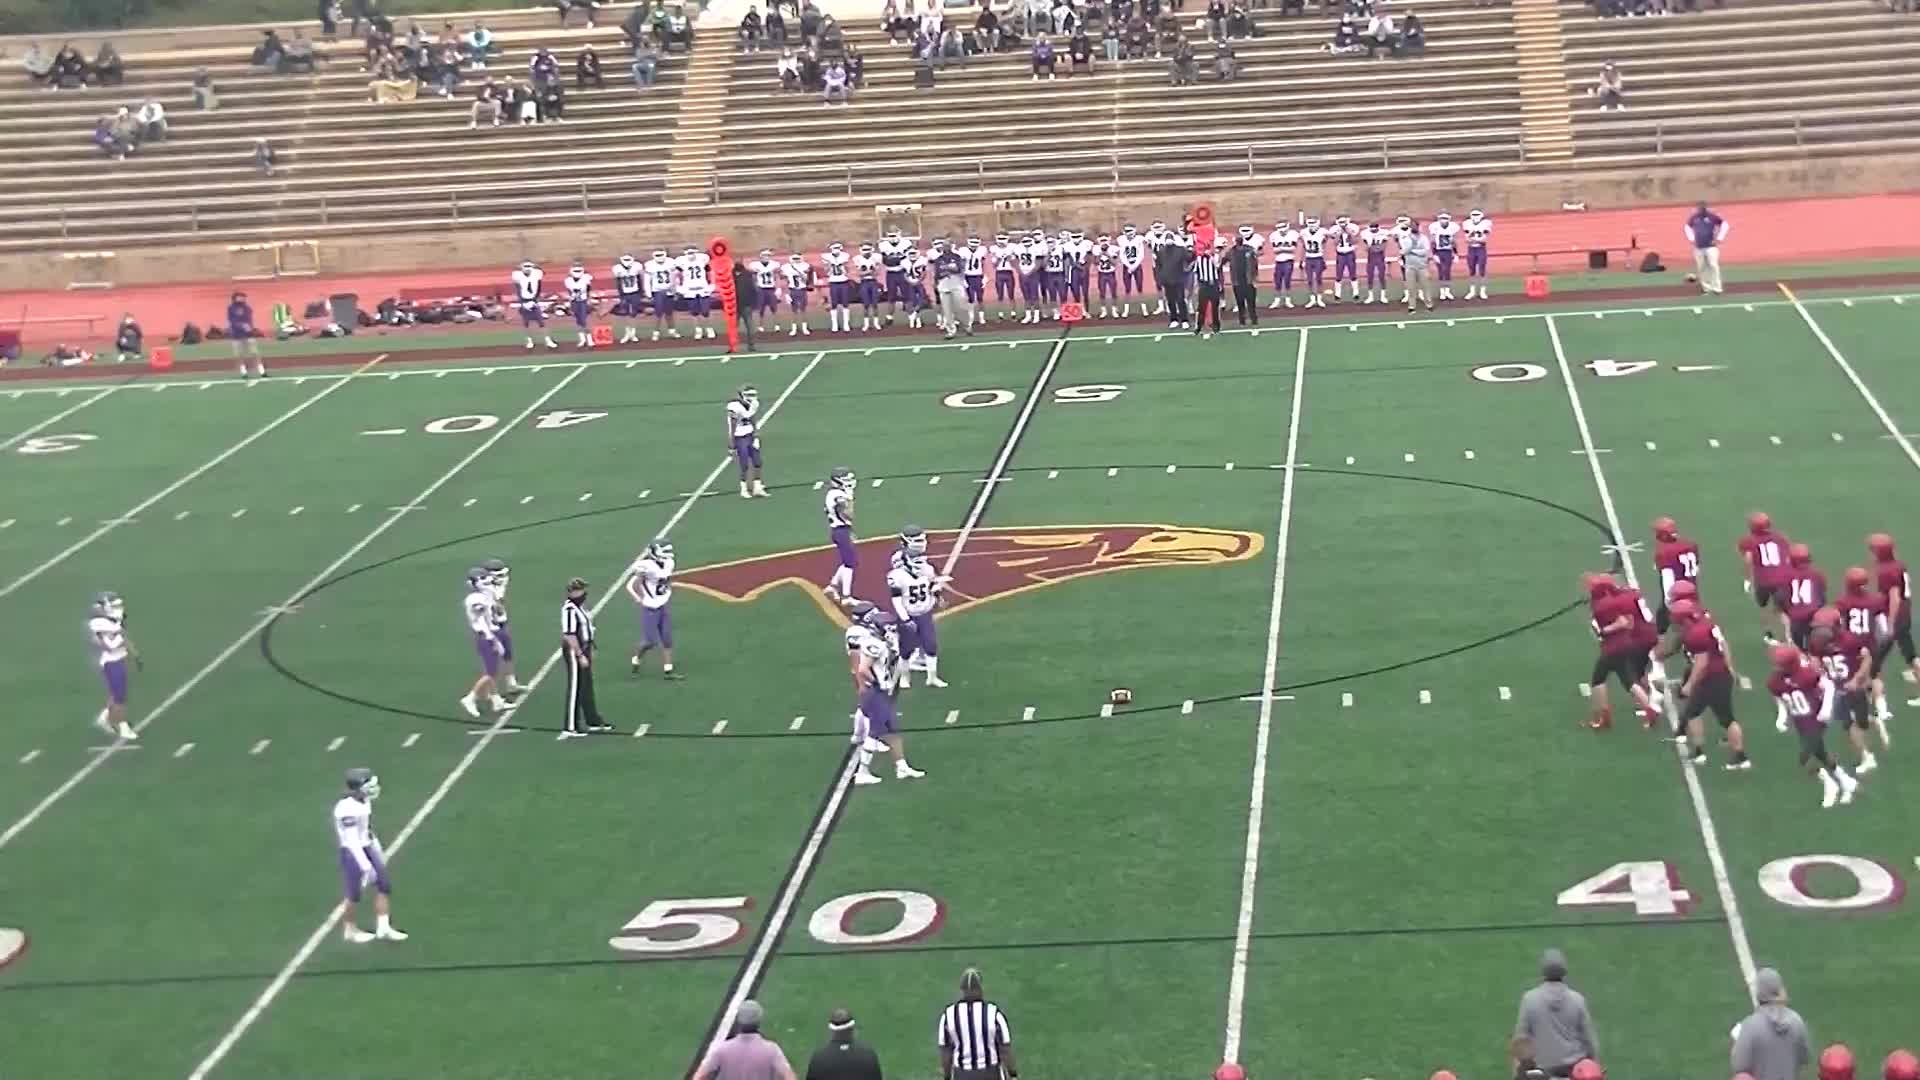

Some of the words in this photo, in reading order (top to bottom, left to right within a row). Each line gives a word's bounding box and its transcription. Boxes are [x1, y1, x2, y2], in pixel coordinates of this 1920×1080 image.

[908, 583, 927, 604] 55
[1791, 578, 1812, 604] 14
[1848, 607, 1870, 635] 21
[1556, 854, 1901, 916] 40
[608, 889, 941, 953] 50
